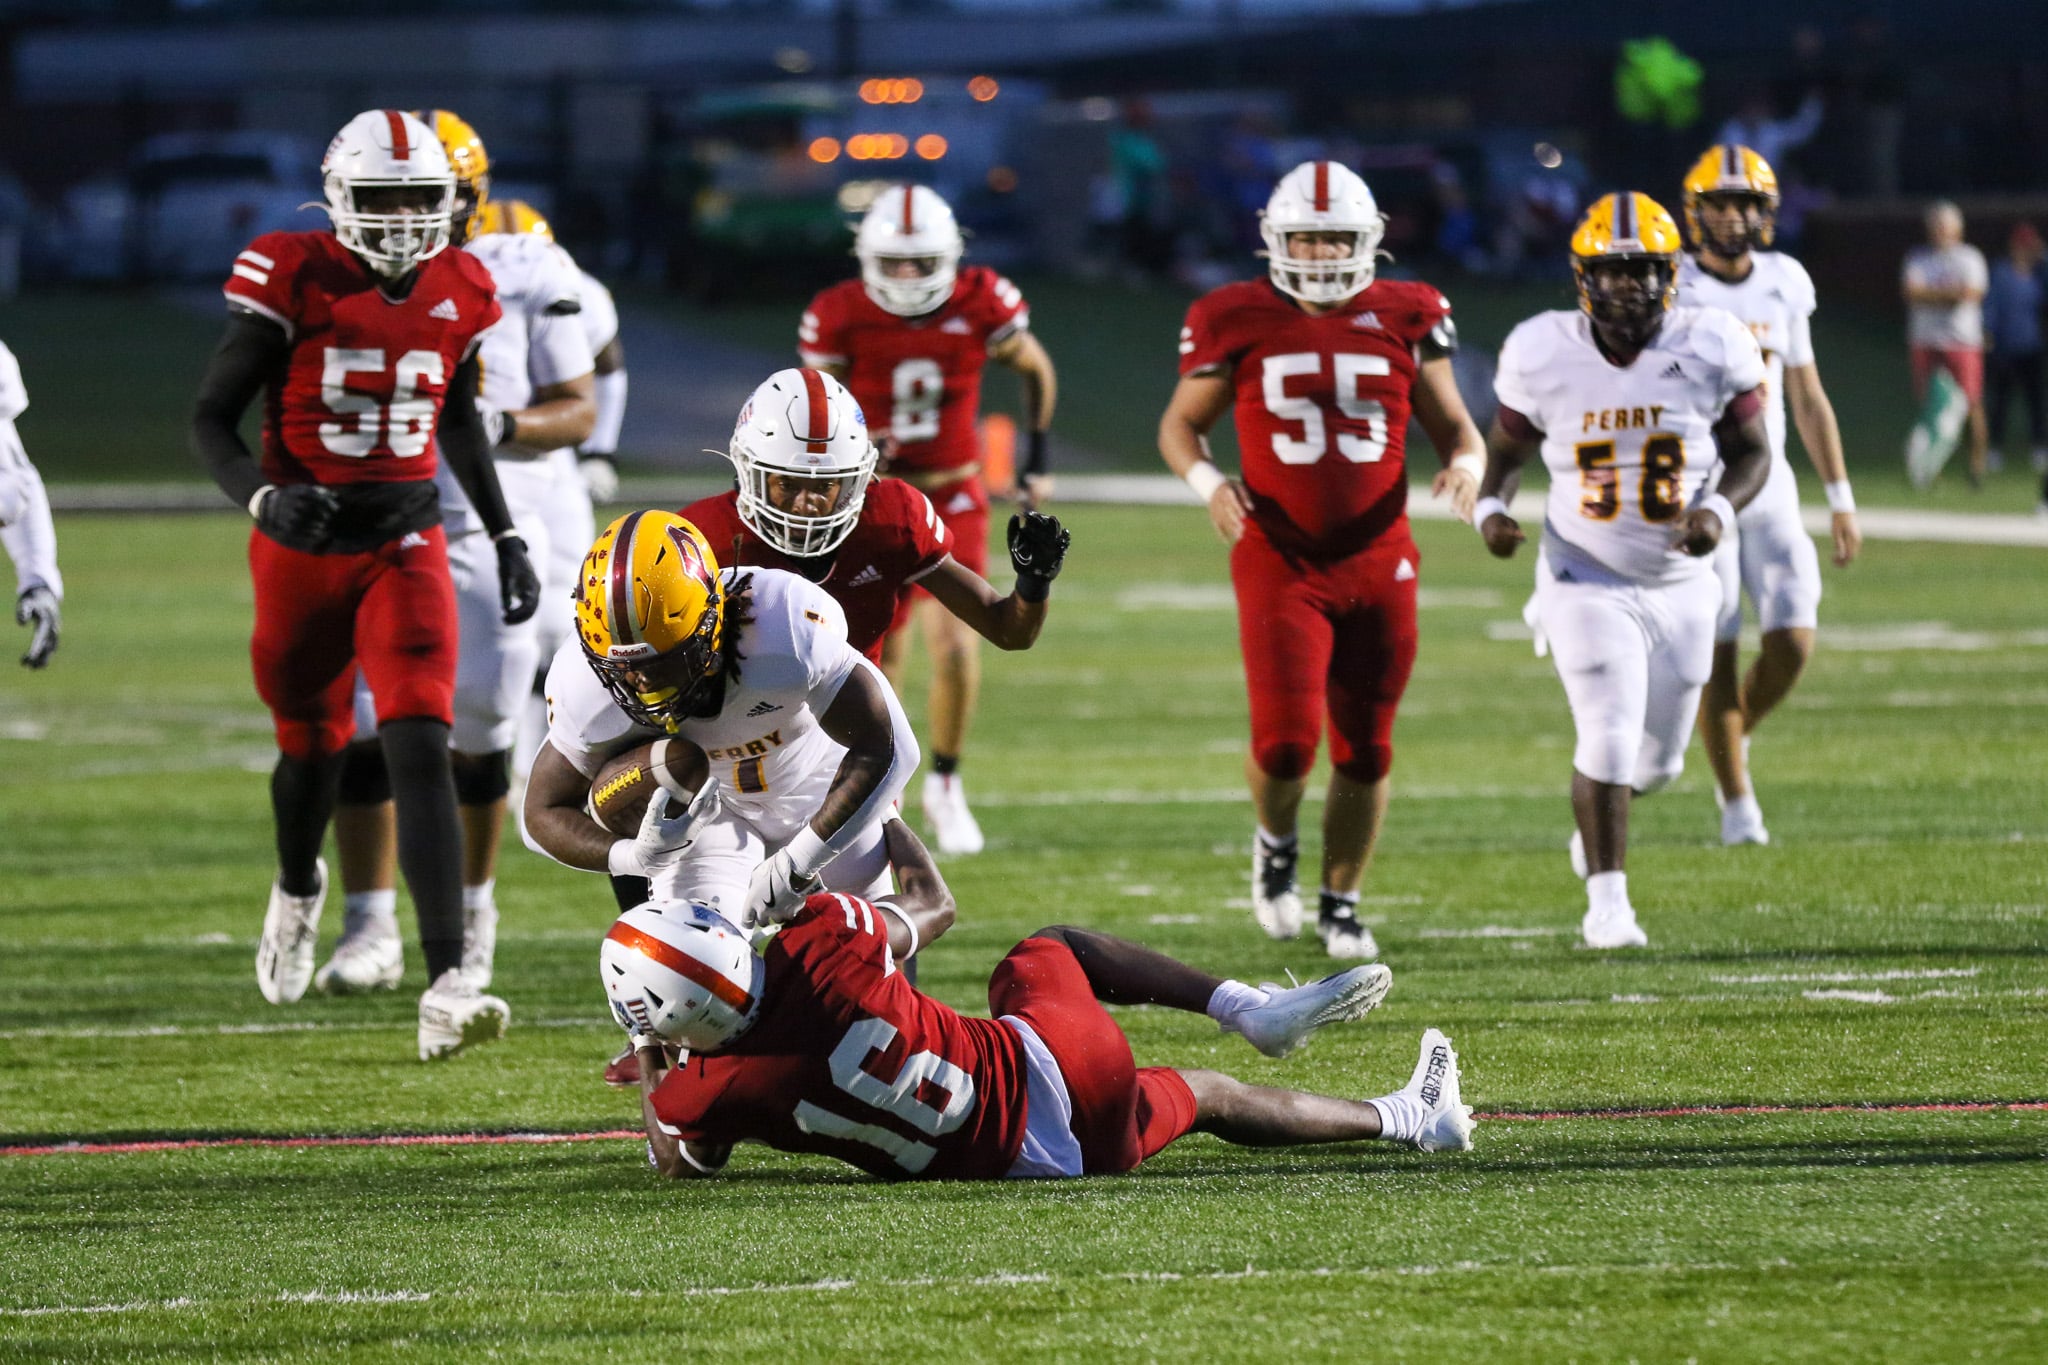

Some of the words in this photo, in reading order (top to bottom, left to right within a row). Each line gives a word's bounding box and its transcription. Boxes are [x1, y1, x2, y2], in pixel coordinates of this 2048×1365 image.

[320, 347, 444, 457] 56
[892, 359, 942, 442] 8
[1262, 353, 1390, 464] 55
[1583, 407, 1664, 432] PERRY
[1575, 435, 1687, 521] 58
[611, 646, 648, 657] Riddell
[706, 729, 783, 760] ERRY
[734, 755, 768, 793] 1
[794, 1018, 975, 1172] 16
